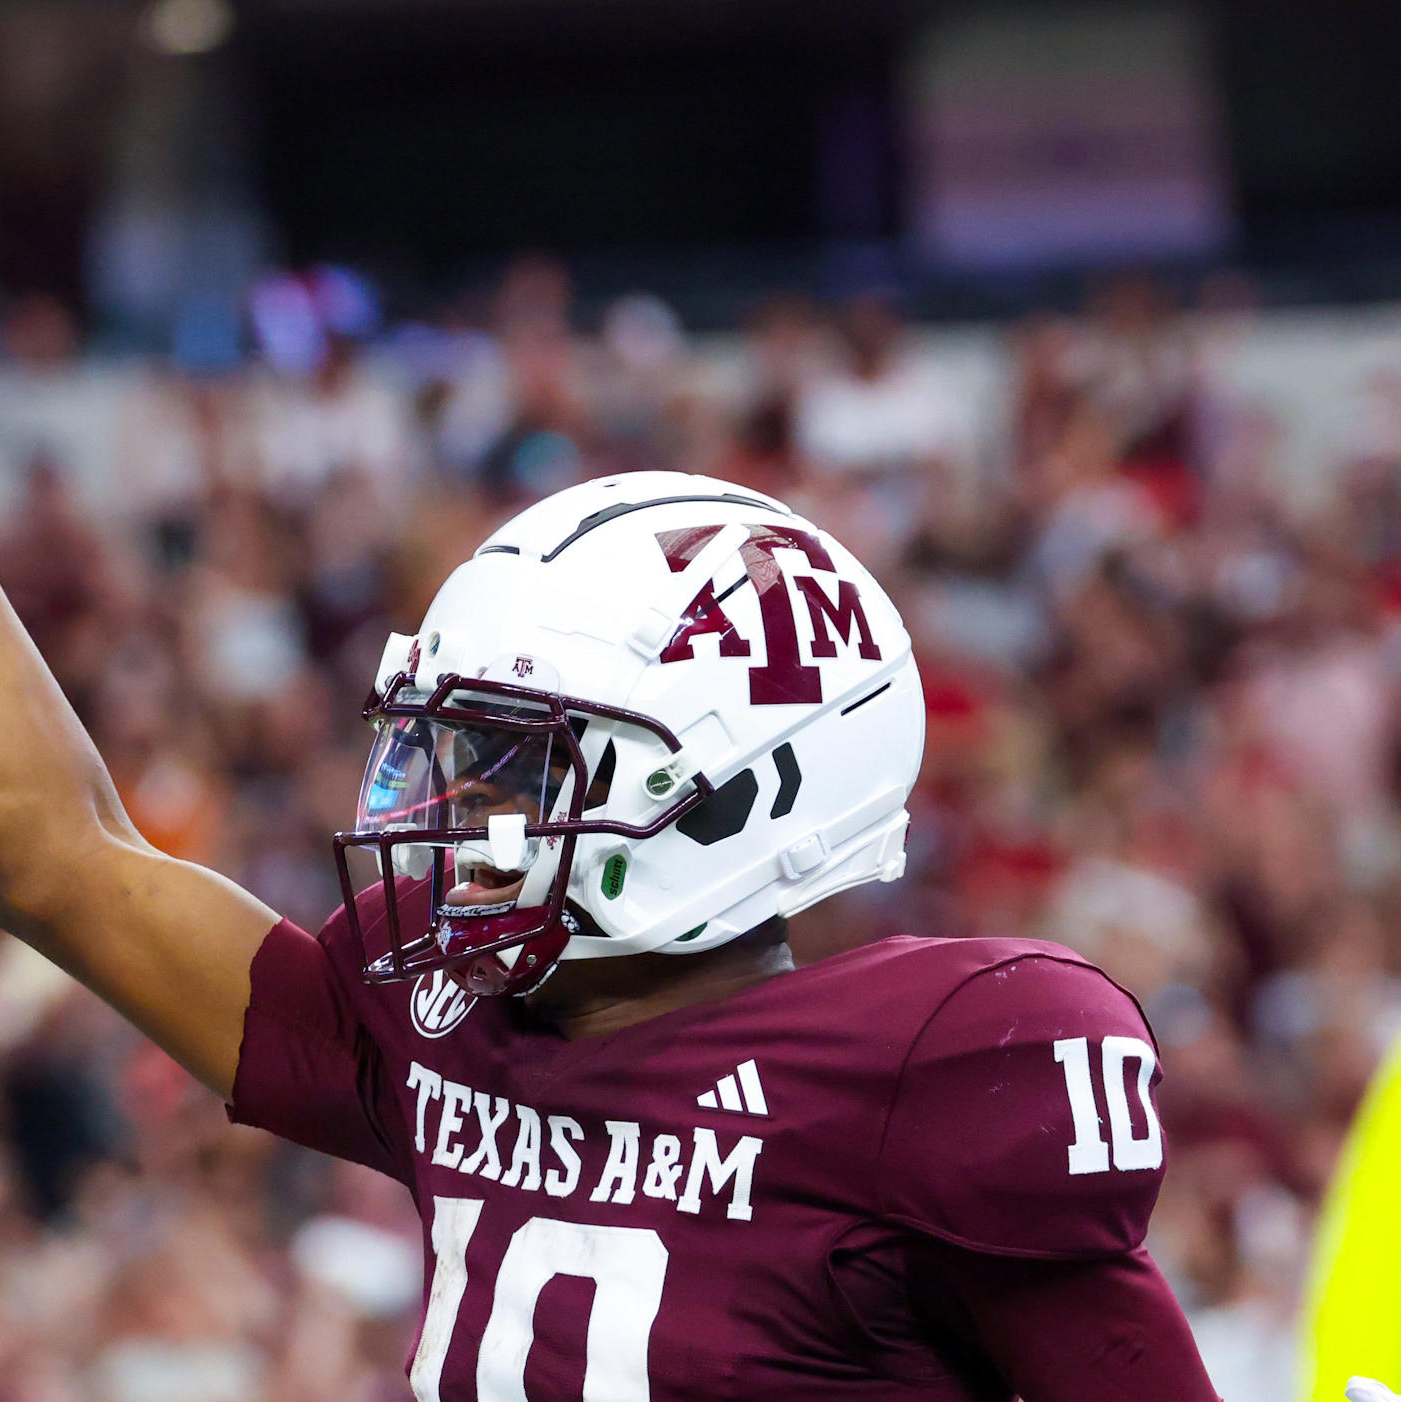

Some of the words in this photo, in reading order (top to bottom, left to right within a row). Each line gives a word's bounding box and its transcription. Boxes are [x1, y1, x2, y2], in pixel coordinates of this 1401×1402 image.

[405, 1060, 584, 1198] TEXAS
[589, 1119, 764, 1222] A&M
[1053, 1035, 1163, 1176] 10
